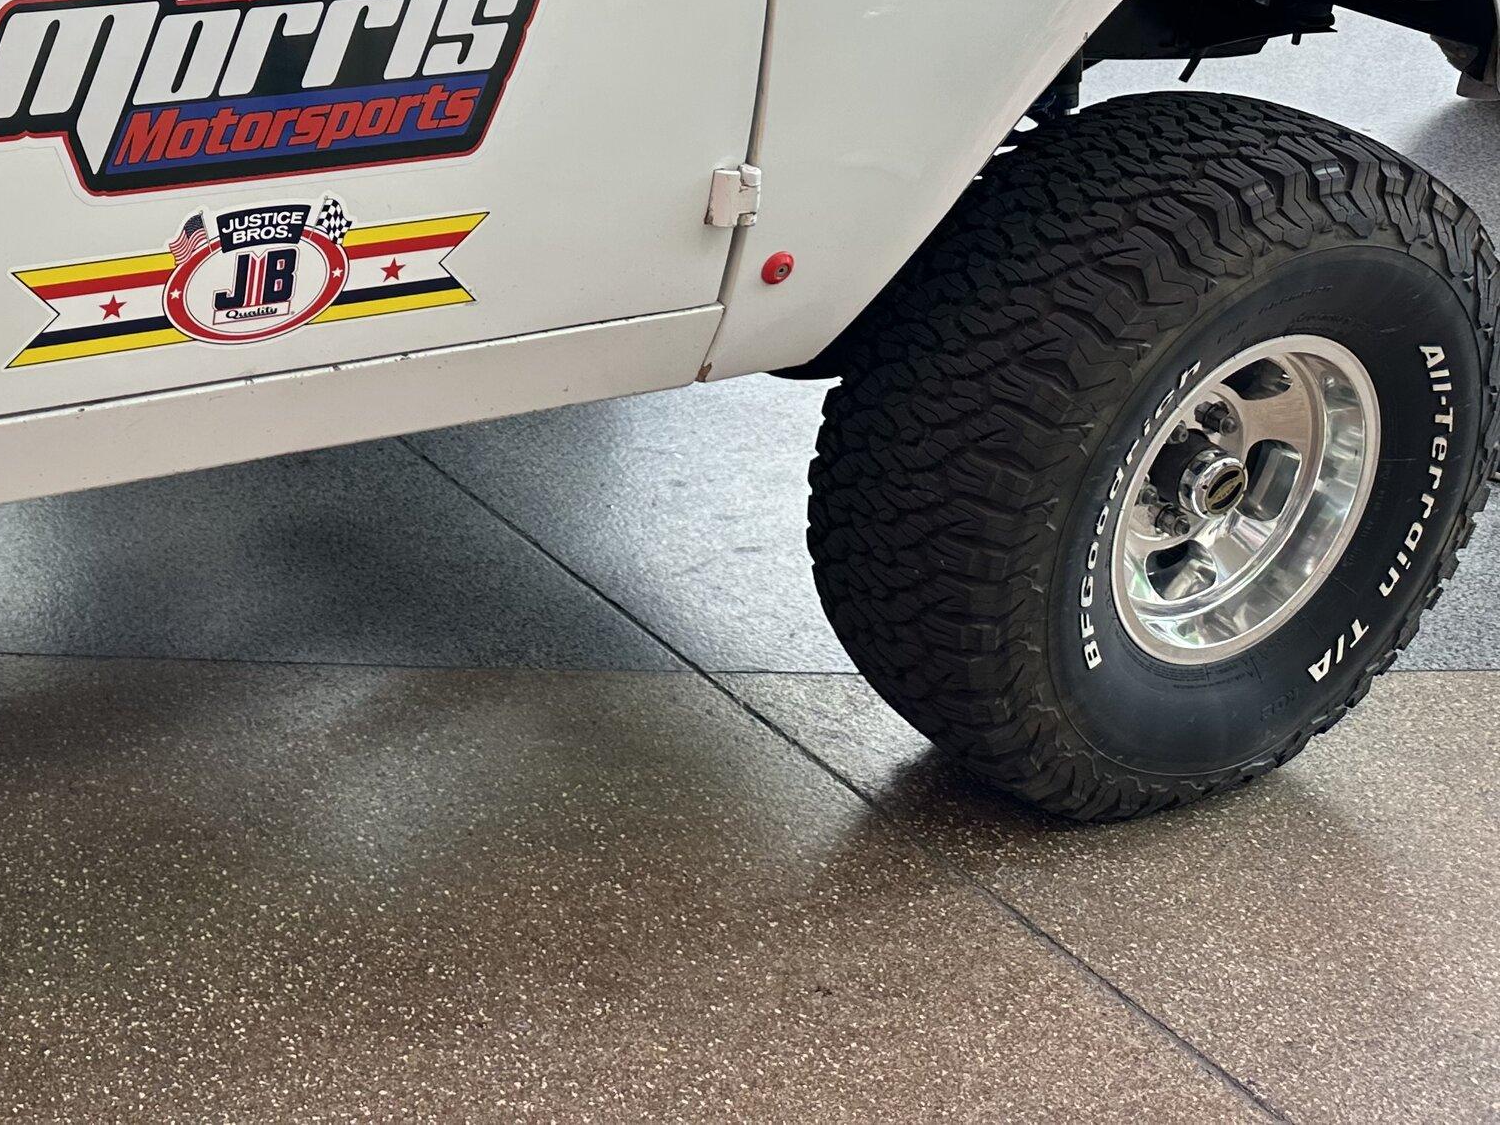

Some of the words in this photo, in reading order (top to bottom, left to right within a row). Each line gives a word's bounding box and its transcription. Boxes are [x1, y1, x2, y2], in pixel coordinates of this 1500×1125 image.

[112, 82, 483, 167] Motorsports
[221, 211, 305, 234] JUSTICE
[232, 227, 293, 245] BROS.
[225, 305, 278, 320] Quality
[1379, 345, 1454, 598] All-Terrain
